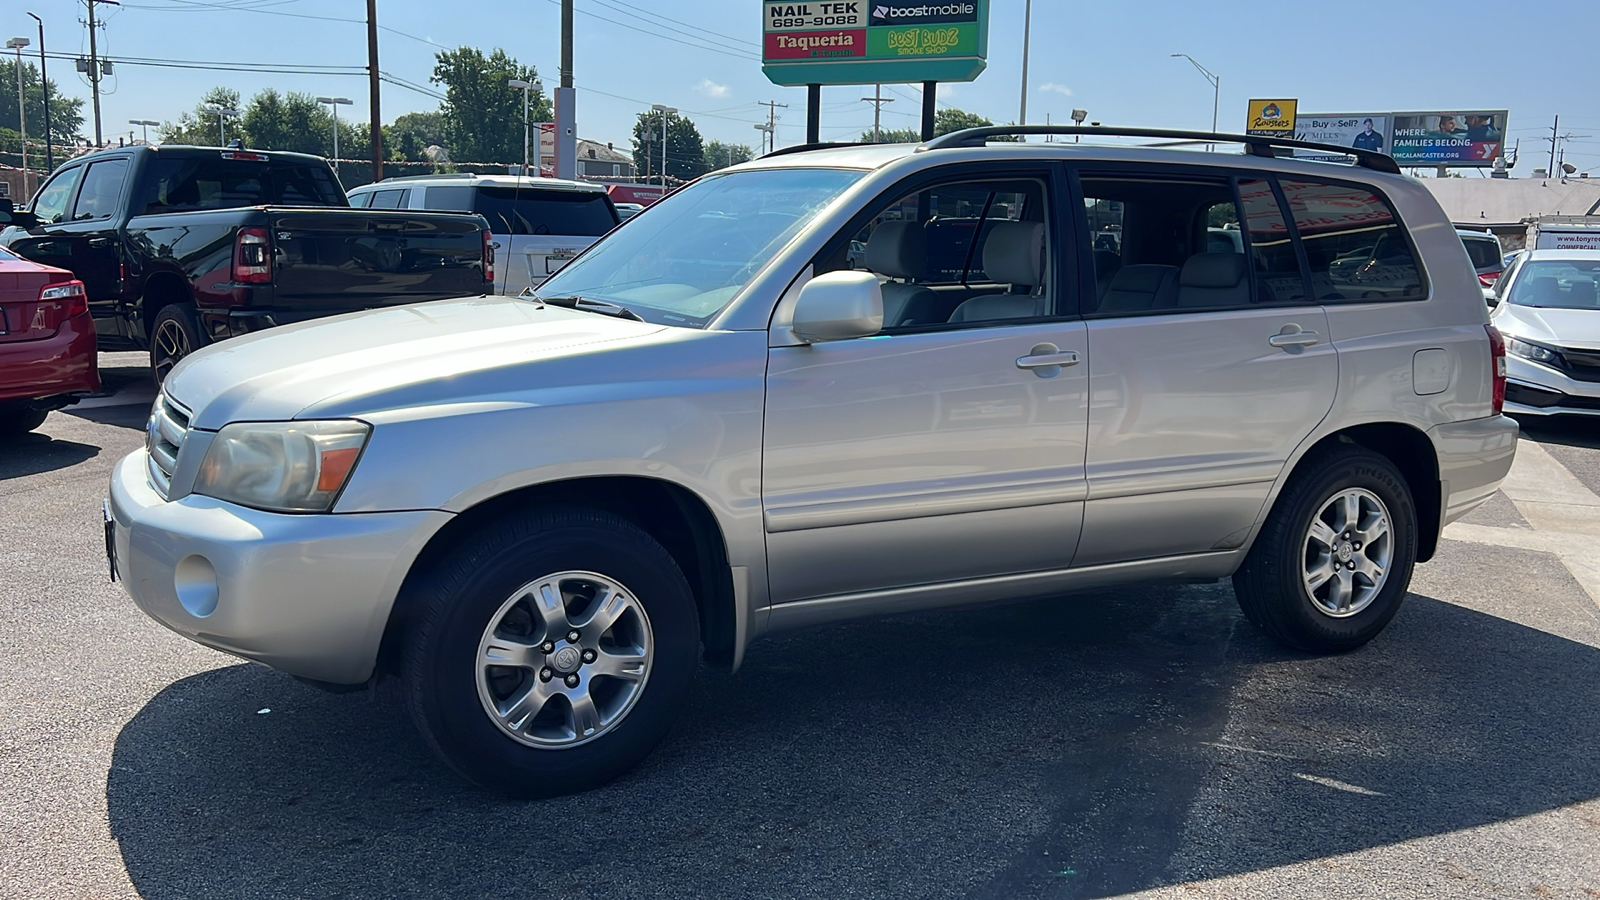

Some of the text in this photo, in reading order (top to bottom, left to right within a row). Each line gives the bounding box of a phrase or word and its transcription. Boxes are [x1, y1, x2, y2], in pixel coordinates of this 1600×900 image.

[771, 2, 858, 17] NAIL TEK
[772, 15, 857, 28] 689-9088
[897, 46, 947, 55] SMOKE SHOP
[1253, 117, 1290, 128] Roosters
[1312, 120, 1329, 129] Buy
[1338, 120, 1358, 128] Sell?
[1395, 128, 1426, 136] WHERE
[1393, 139, 1473, 147] FAMILIES BELONG.
